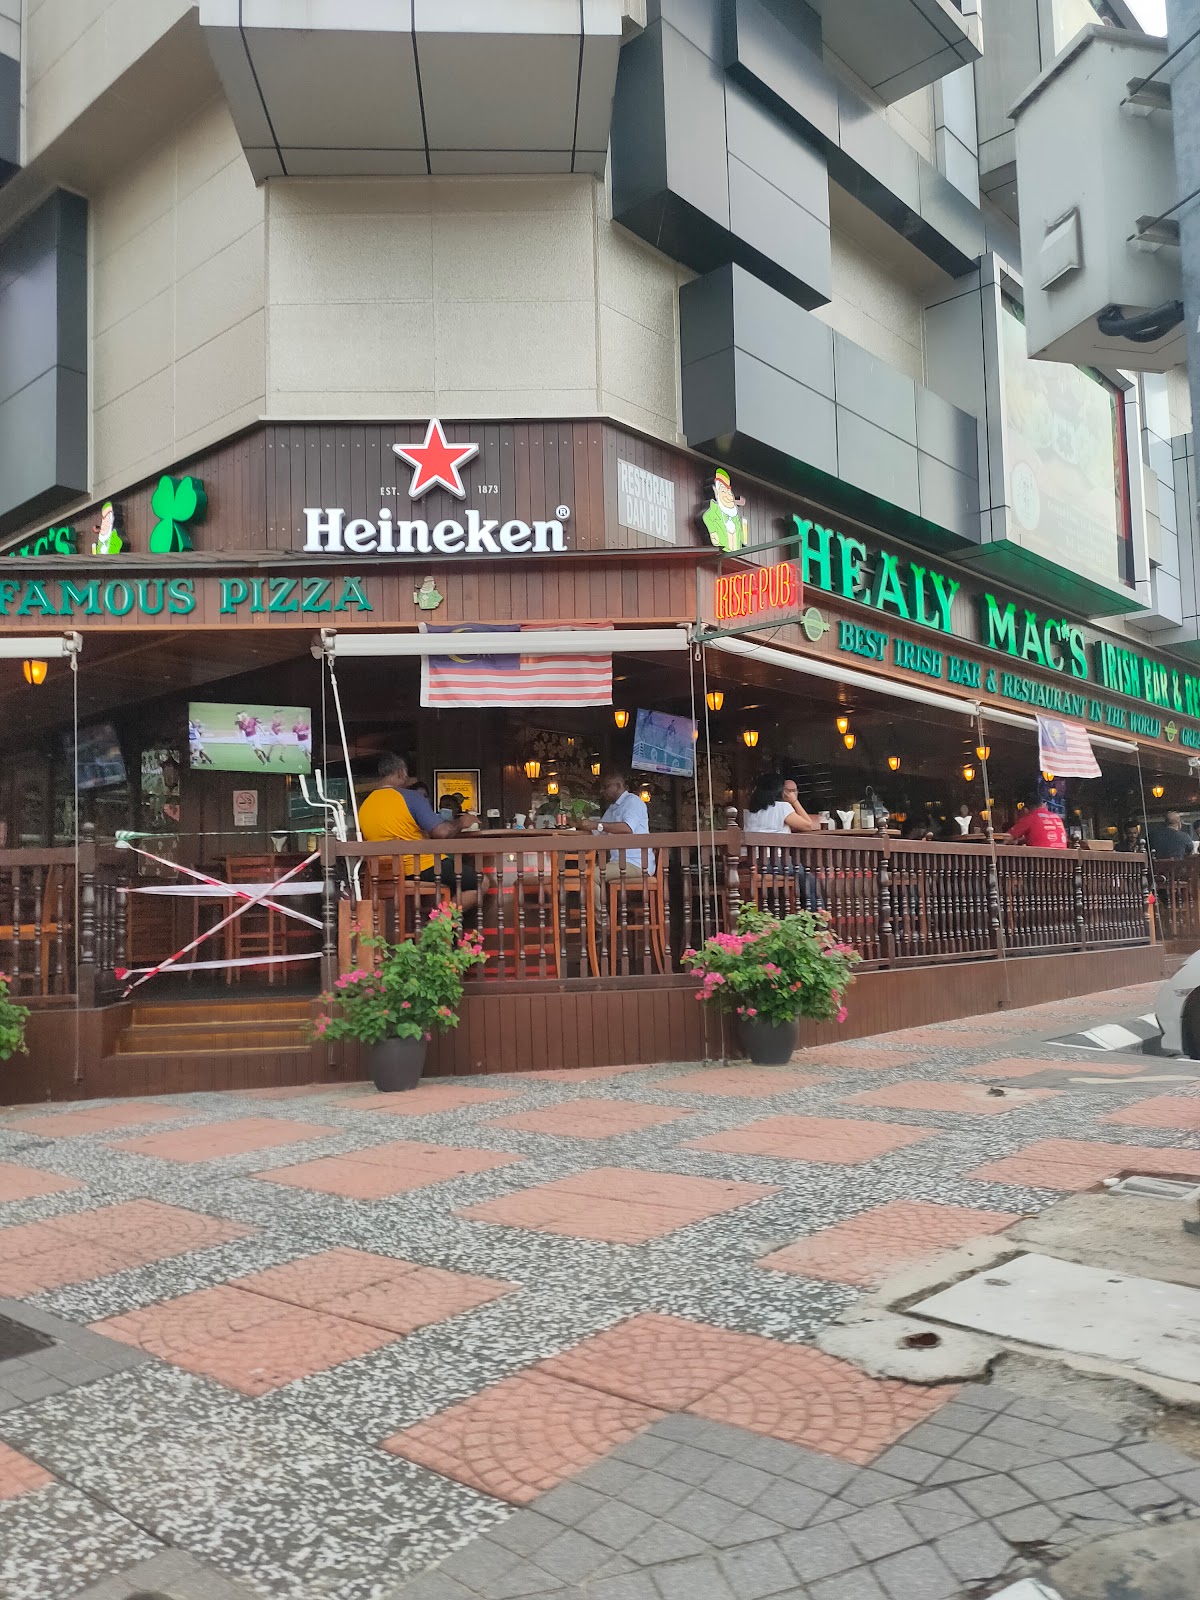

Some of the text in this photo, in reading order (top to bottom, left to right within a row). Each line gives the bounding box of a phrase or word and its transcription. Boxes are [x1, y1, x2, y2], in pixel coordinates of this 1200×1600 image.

[380, 484, 499, 496] EST. 1873
[620, 462, 673, 510] RESTORAN
[626, 494, 669, 537] DAN PUB
[0, 576, 374, 616] FAMOUS PIZZA
[715, 562, 791, 619] IRISH PUB
[793, 513, 960, 634] HEALY
[984, 592, 1088, 680] MAC'S
[1101, 641, 1141, 698] IRISH
[1143, 656, 1170, 708] BAR
[1172, 667, 1183, 713] &
[838, 620, 888, 661] BEST
[893, 638, 943, 678] IRISH
[947, 655, 982, 688] BAR
[985, 667, 998, 693] &
[1001, 672, 1086, 718] RESTAURANT
[1088, 699, 1103, 722] IN
[1105, 704, 1127, 729] THE
[1128, 711, 1161, 738] WORLD
